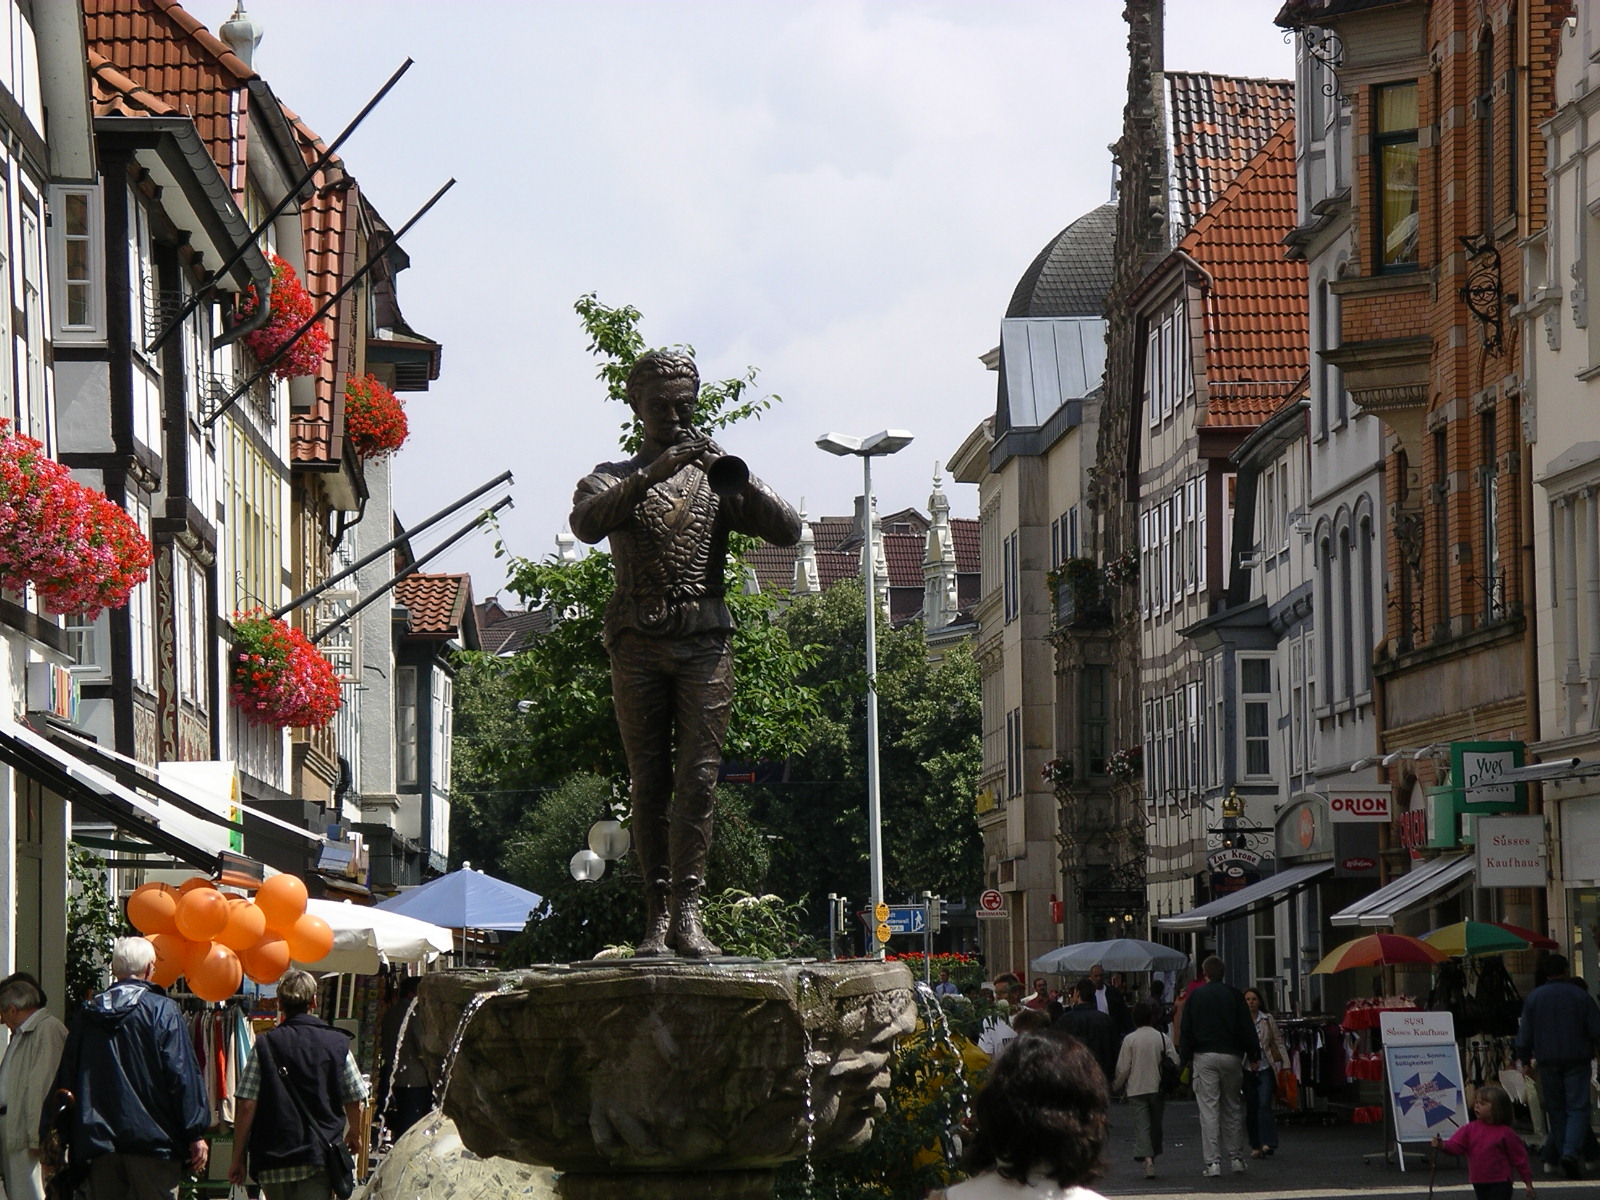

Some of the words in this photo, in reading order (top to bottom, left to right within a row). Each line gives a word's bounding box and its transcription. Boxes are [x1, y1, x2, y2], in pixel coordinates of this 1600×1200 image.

[1476, 757, 1504, 779] Yves
[1331, 798, 1388, 816] ORION
[1212, 853, 1226, 864] Zur
[1231, 849, 1256, 863] Krone
[1486, 857, 1540, 868] Kaufhaus
[1413, 1028, 1449, 1036] Kaufhaus
